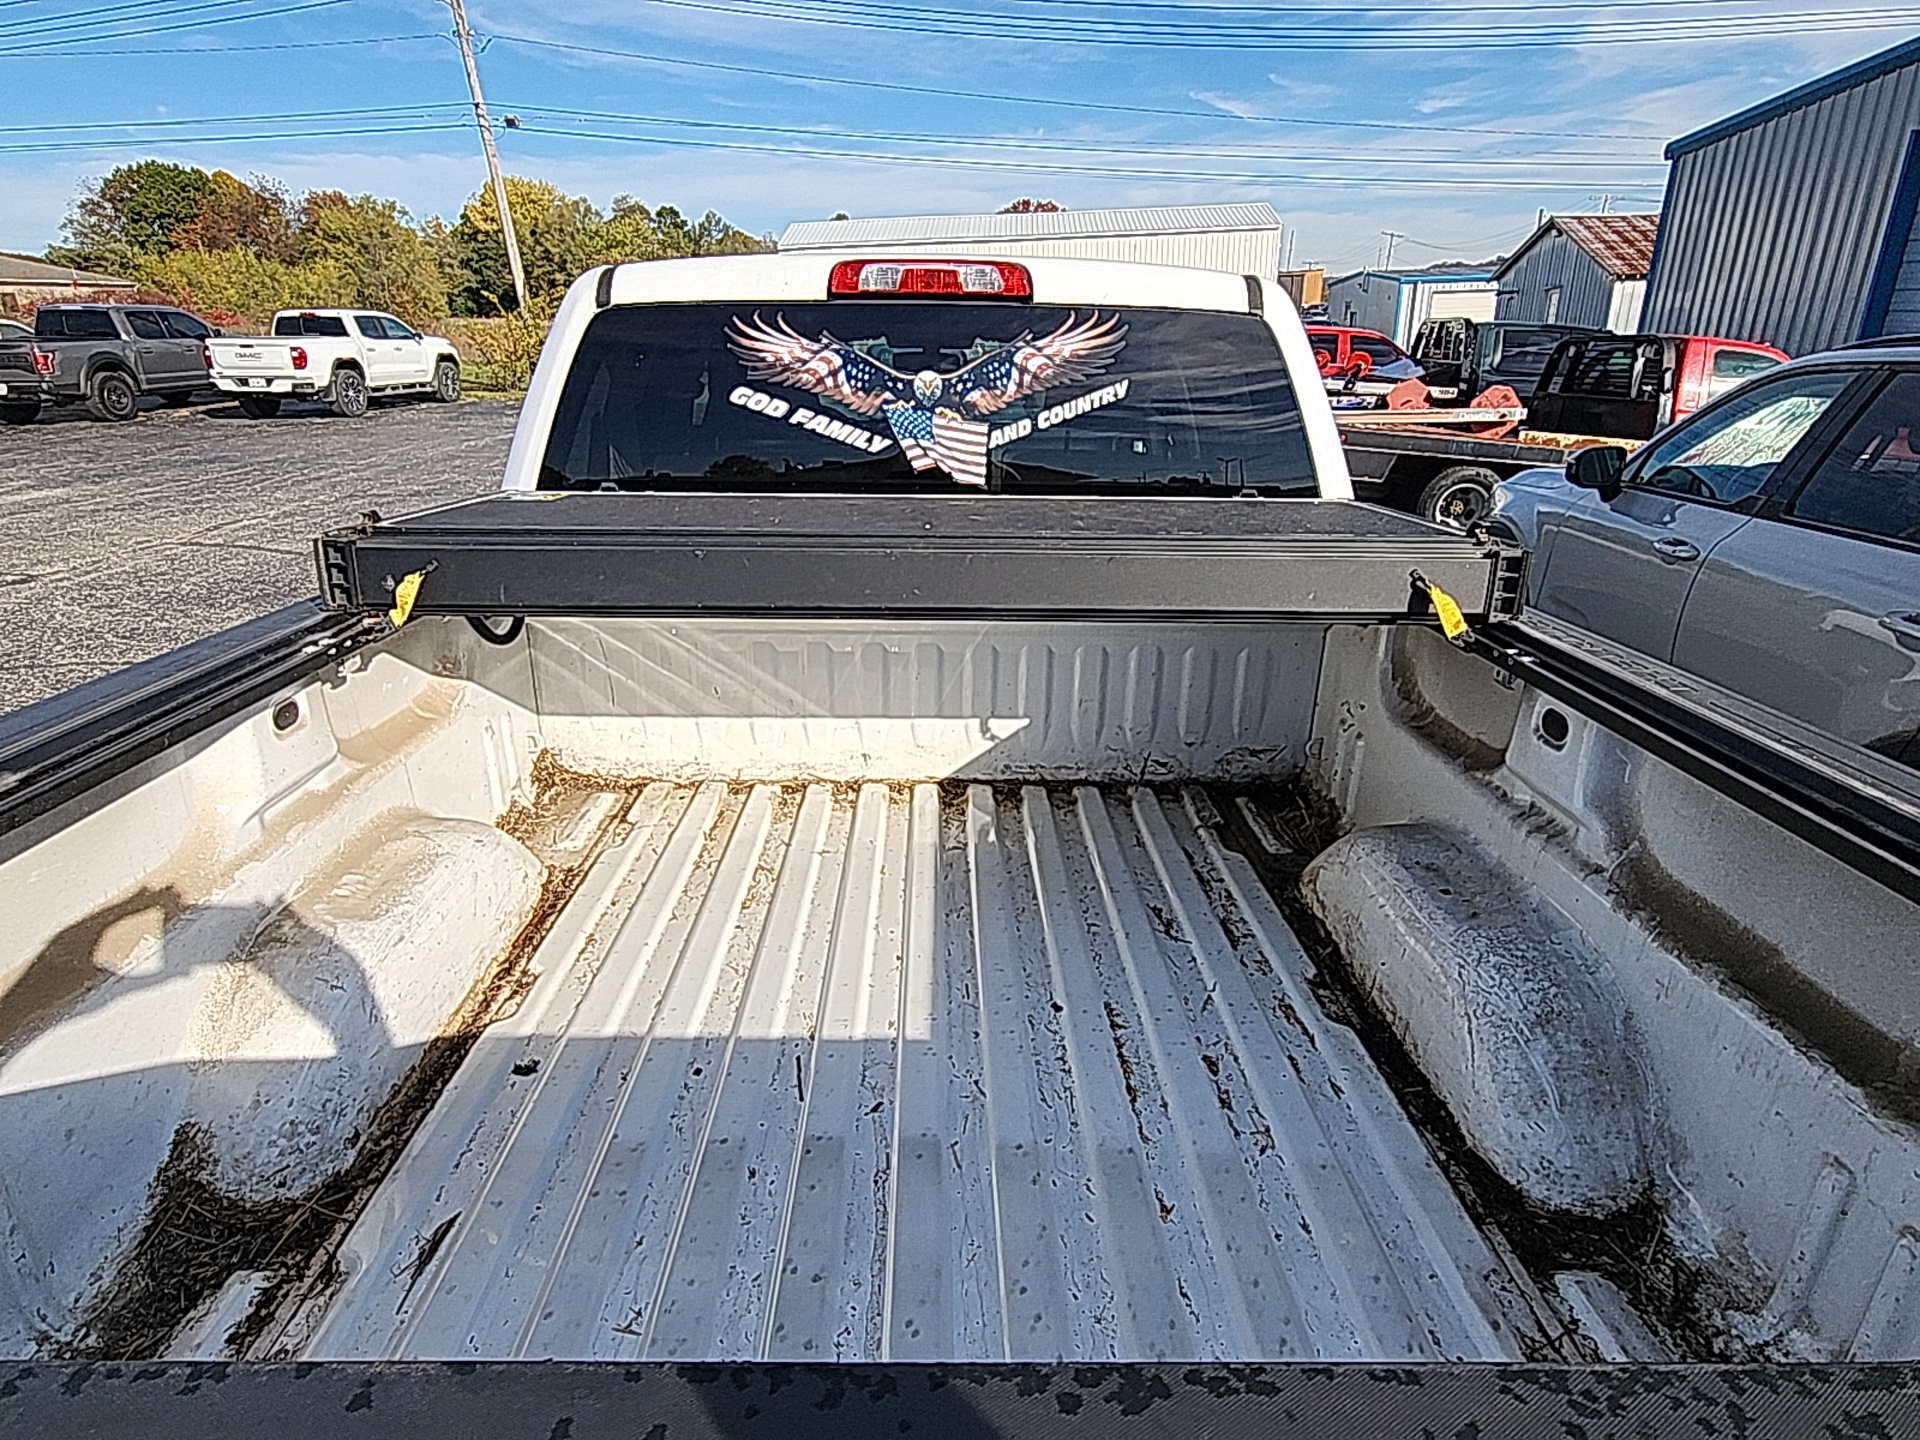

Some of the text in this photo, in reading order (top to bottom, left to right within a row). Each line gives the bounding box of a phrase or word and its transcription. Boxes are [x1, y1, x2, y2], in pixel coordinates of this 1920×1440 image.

[729, 386, 893, 453] GOD FAMILY
[989, 379, 1129, 449] AND COUNTRY
